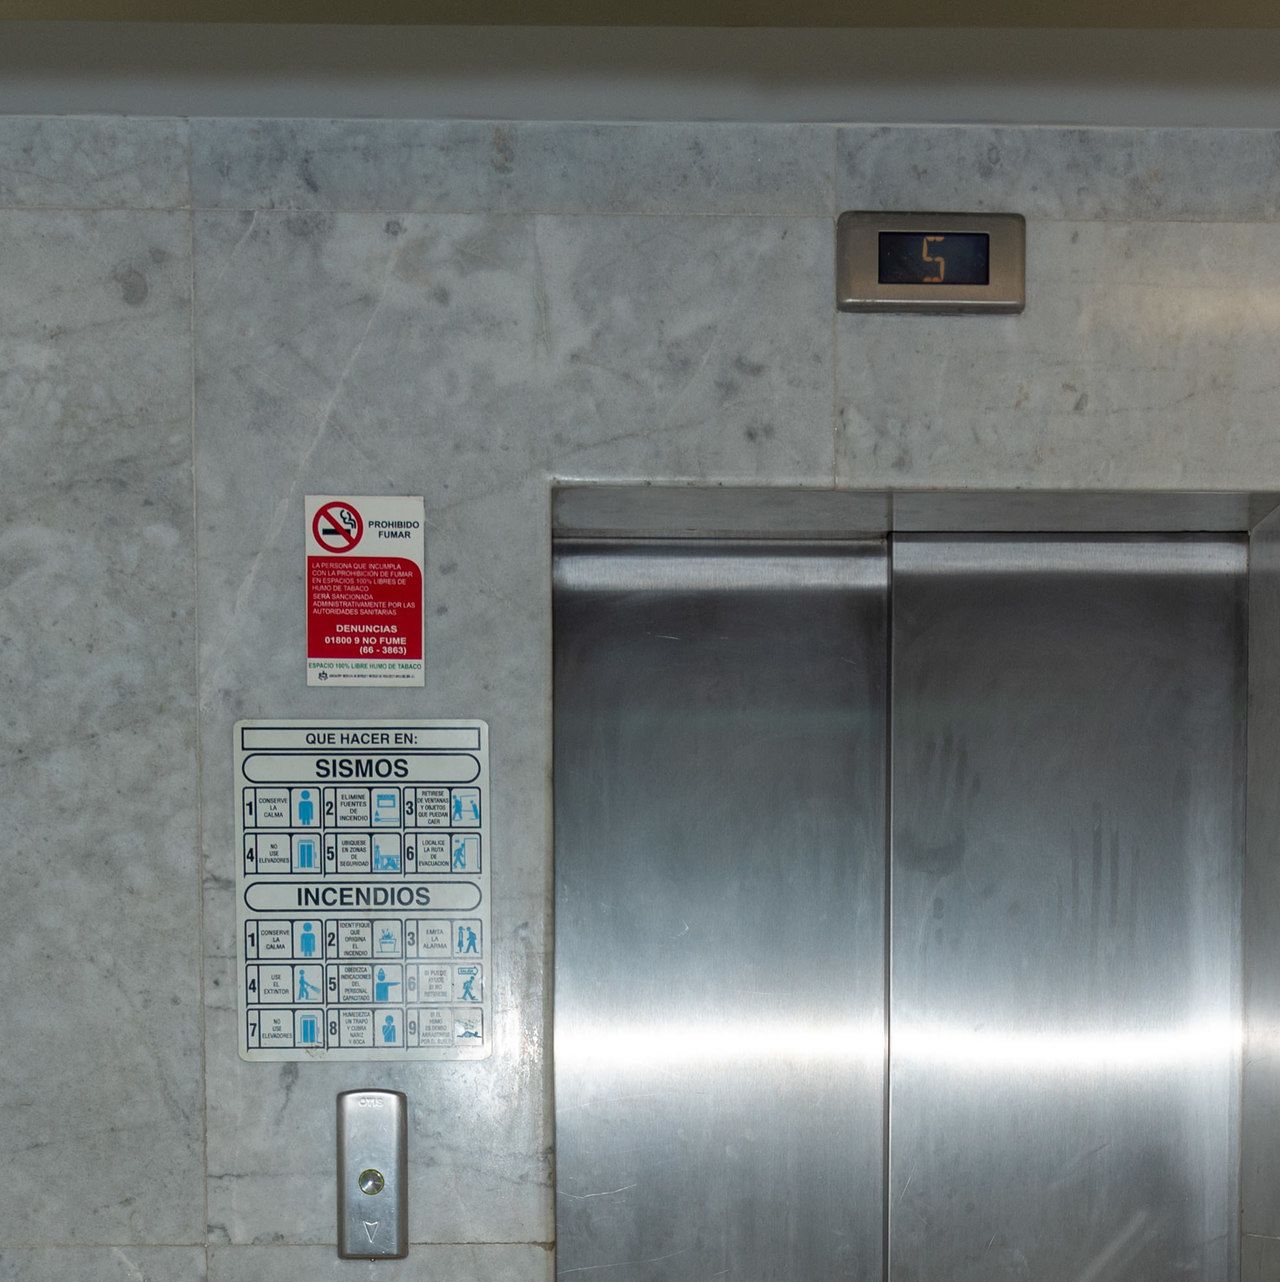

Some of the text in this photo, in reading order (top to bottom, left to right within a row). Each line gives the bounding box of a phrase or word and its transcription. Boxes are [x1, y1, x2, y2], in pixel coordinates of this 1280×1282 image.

[922, 236, 945, 283] 5
[368, 520, 420, 529] PROHIBIDO
[378, 530, 411, 539] FUMAR
[336, 624, 398, 633] DENUNCIAS
[324, 636, 407, 645] 01800 9 NO FUME
[359, 646, 374, 655] (66
[382, 646, 407, 656] 3863)
[305, 732, 418, 745] QUE HACER EN:
[315, 758, 409, 778] SISMOS
[245, 801, 254, 816] 1
[325, 801, 334, 816] 2
[405, 801, 414, 816] 3
[246, 847, 254, 862] 4
[326, 846, 334, 861] 5
[406, 846, 414, 861] 6
[297, 887, 431, 906] INCENDIOS
[247, 932, 256, 947] 1
[327, 932, 336, 947] 2
[407, 932, 416, 947] 3
[248, 978, 257, 993] 4
[328, 977, 337, 992] 5
[407, 976, 416, 991] 6
[249, 1023, 258, 1038] 7
[329, 1021, 338, 1036] 8
[408, 1020, 417, 1035] 9
[359, 1096, 385, 1108] OTIS
